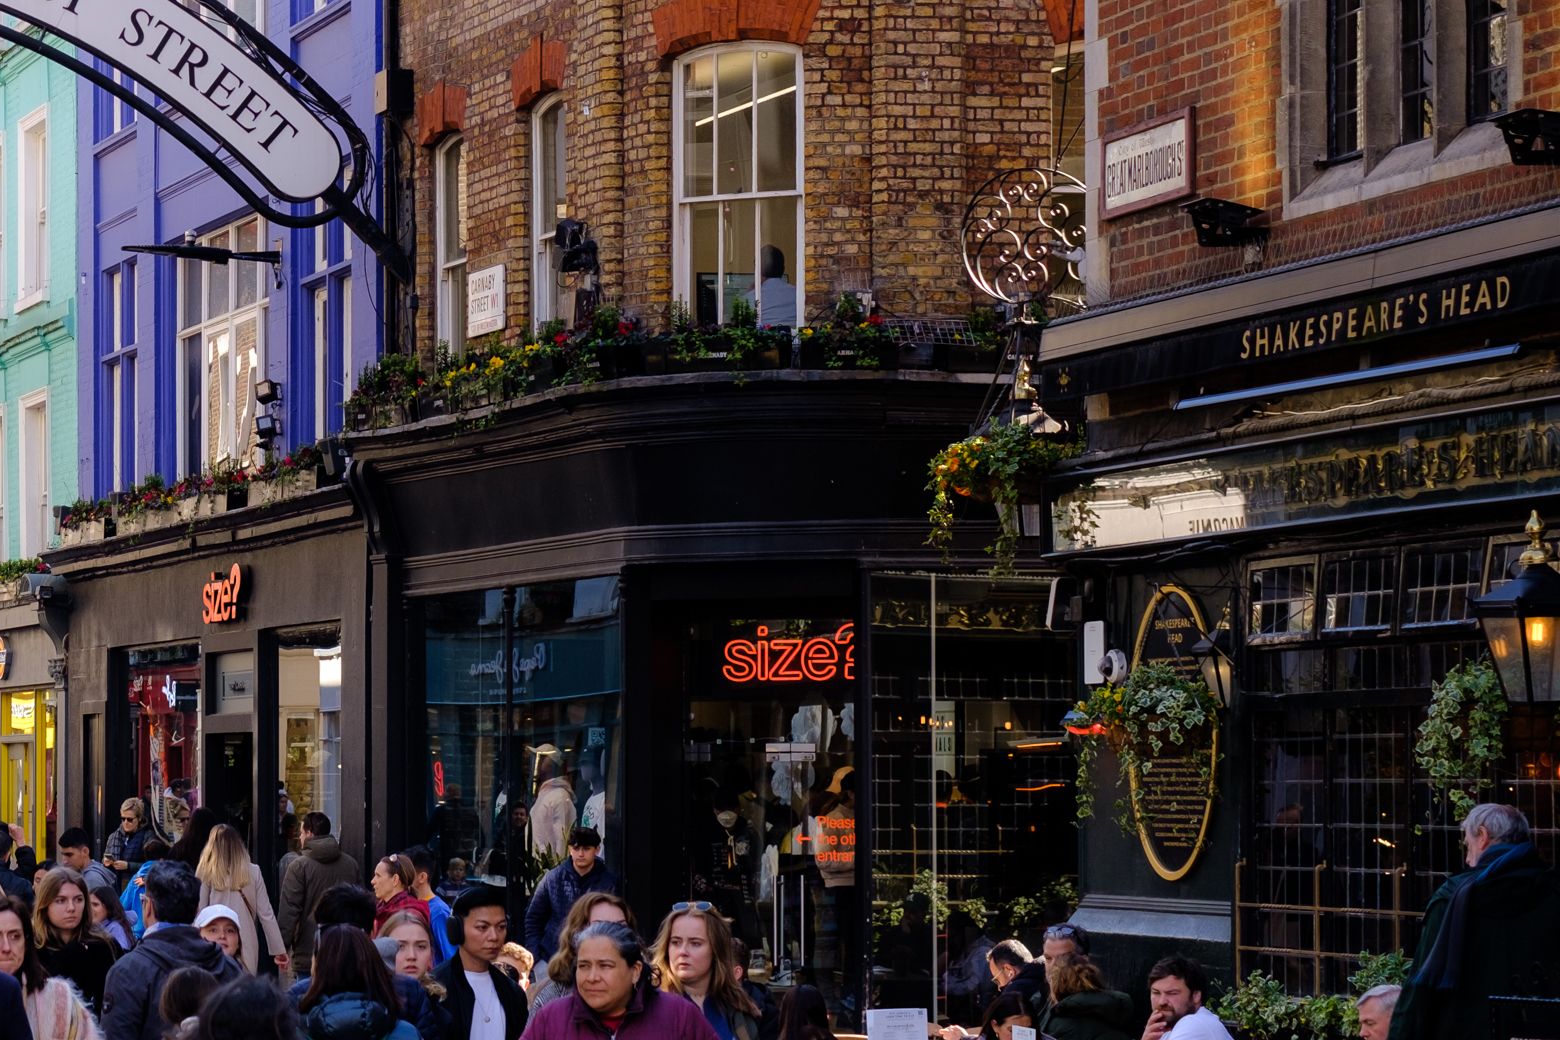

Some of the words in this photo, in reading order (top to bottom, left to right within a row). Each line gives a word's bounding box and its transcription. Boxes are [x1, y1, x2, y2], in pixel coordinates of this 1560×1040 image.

[119, 8, 299, 154] STREET
[1107, 159, 1127, 199] GREAT
[1128, 142, 1176, 192] MARLBOROUGH
[470, 294, 489, 315] STREET
[490, 292, 499, 310] W1
[471, 272, 495, 296] CARNABY
[1240, 291, 1428, 360] SHAKESPEARE'S
[1441, 276, 1511, 320] HEAD
[202, 562, 241, 625] size?
